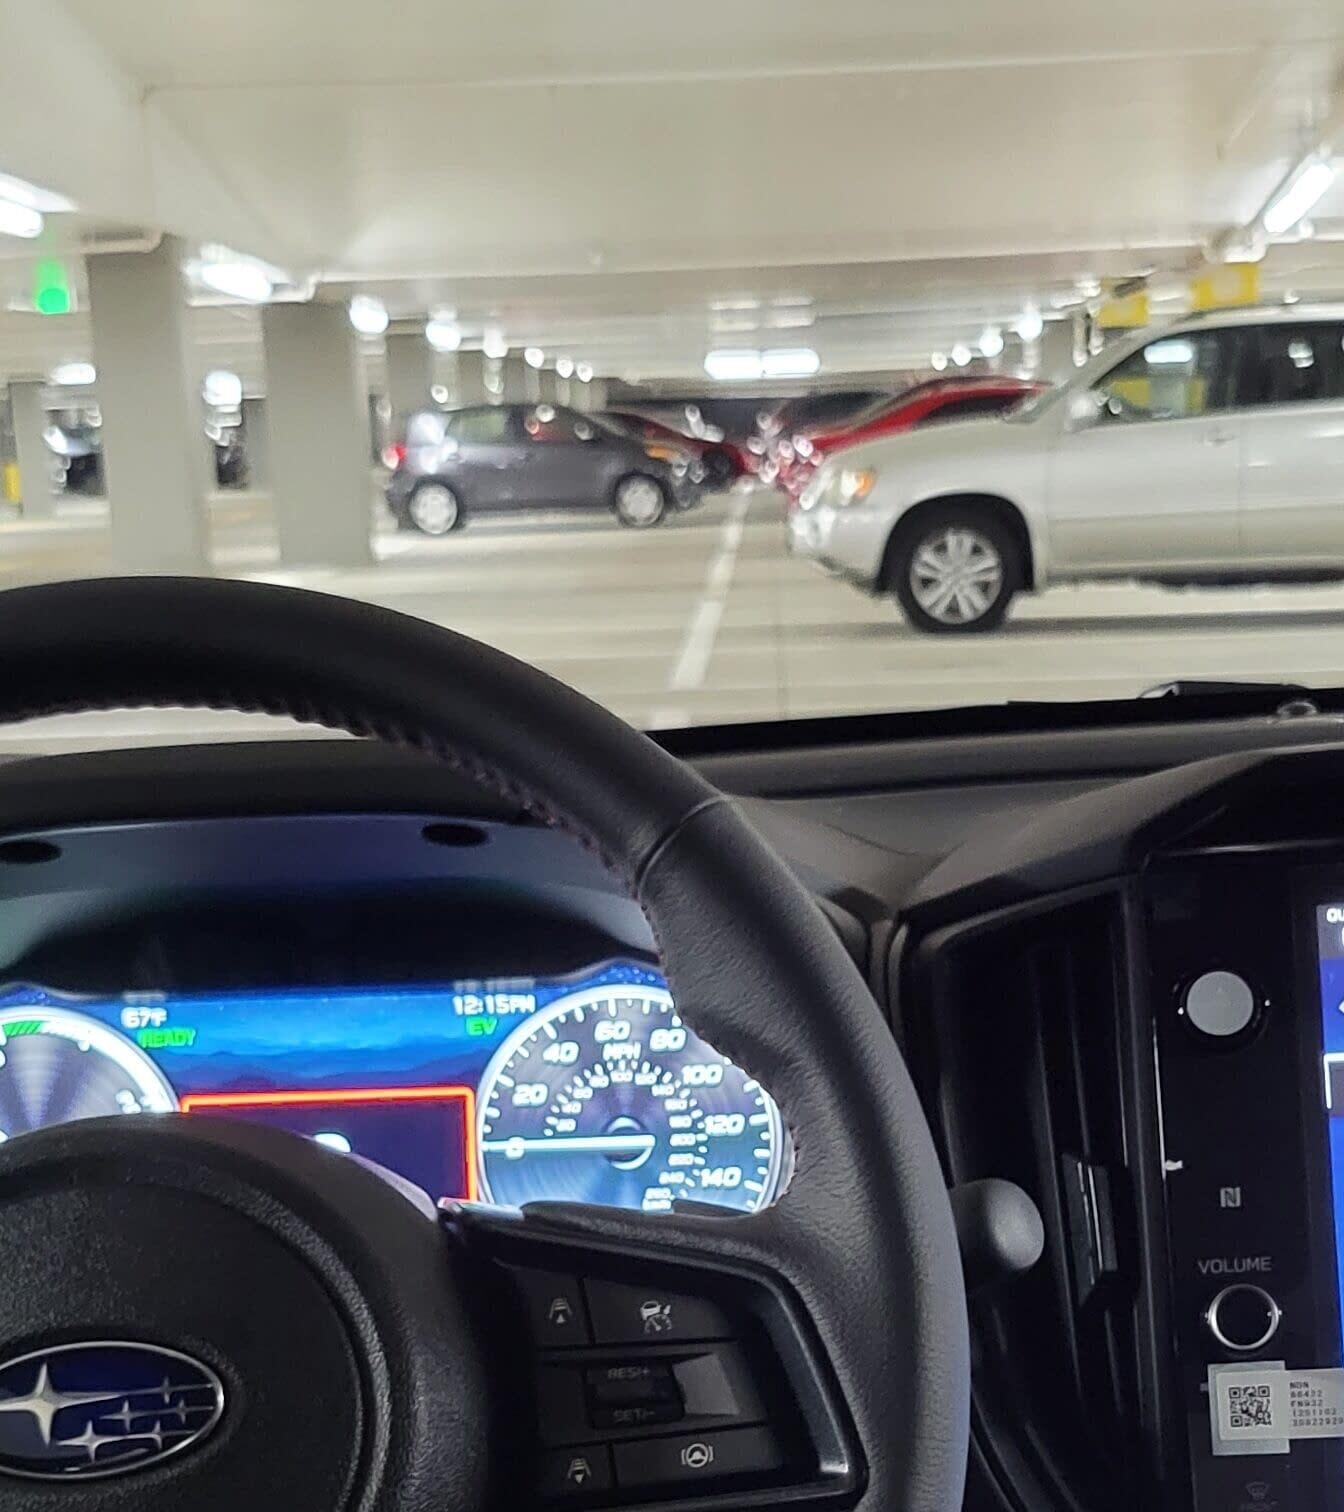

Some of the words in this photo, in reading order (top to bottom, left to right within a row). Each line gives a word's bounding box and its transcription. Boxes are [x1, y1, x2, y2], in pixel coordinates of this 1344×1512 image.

[466, 1017, 497, 1036] EV
[594, 1020, 631, 1042] 60
[138, 1028, 196, 1048] READY
[650, 1028, 686, 1051] 80
[543, 1042, 580, 1064] 40
[682, 1064, 723, 1086] 100
[512, 1083, 548, 1106] 20
[704, 1114, 746, 1136] 120
[700, 1167, 742, 1188] 140
[1197, 1257, 1273, 1276] VOLUME
